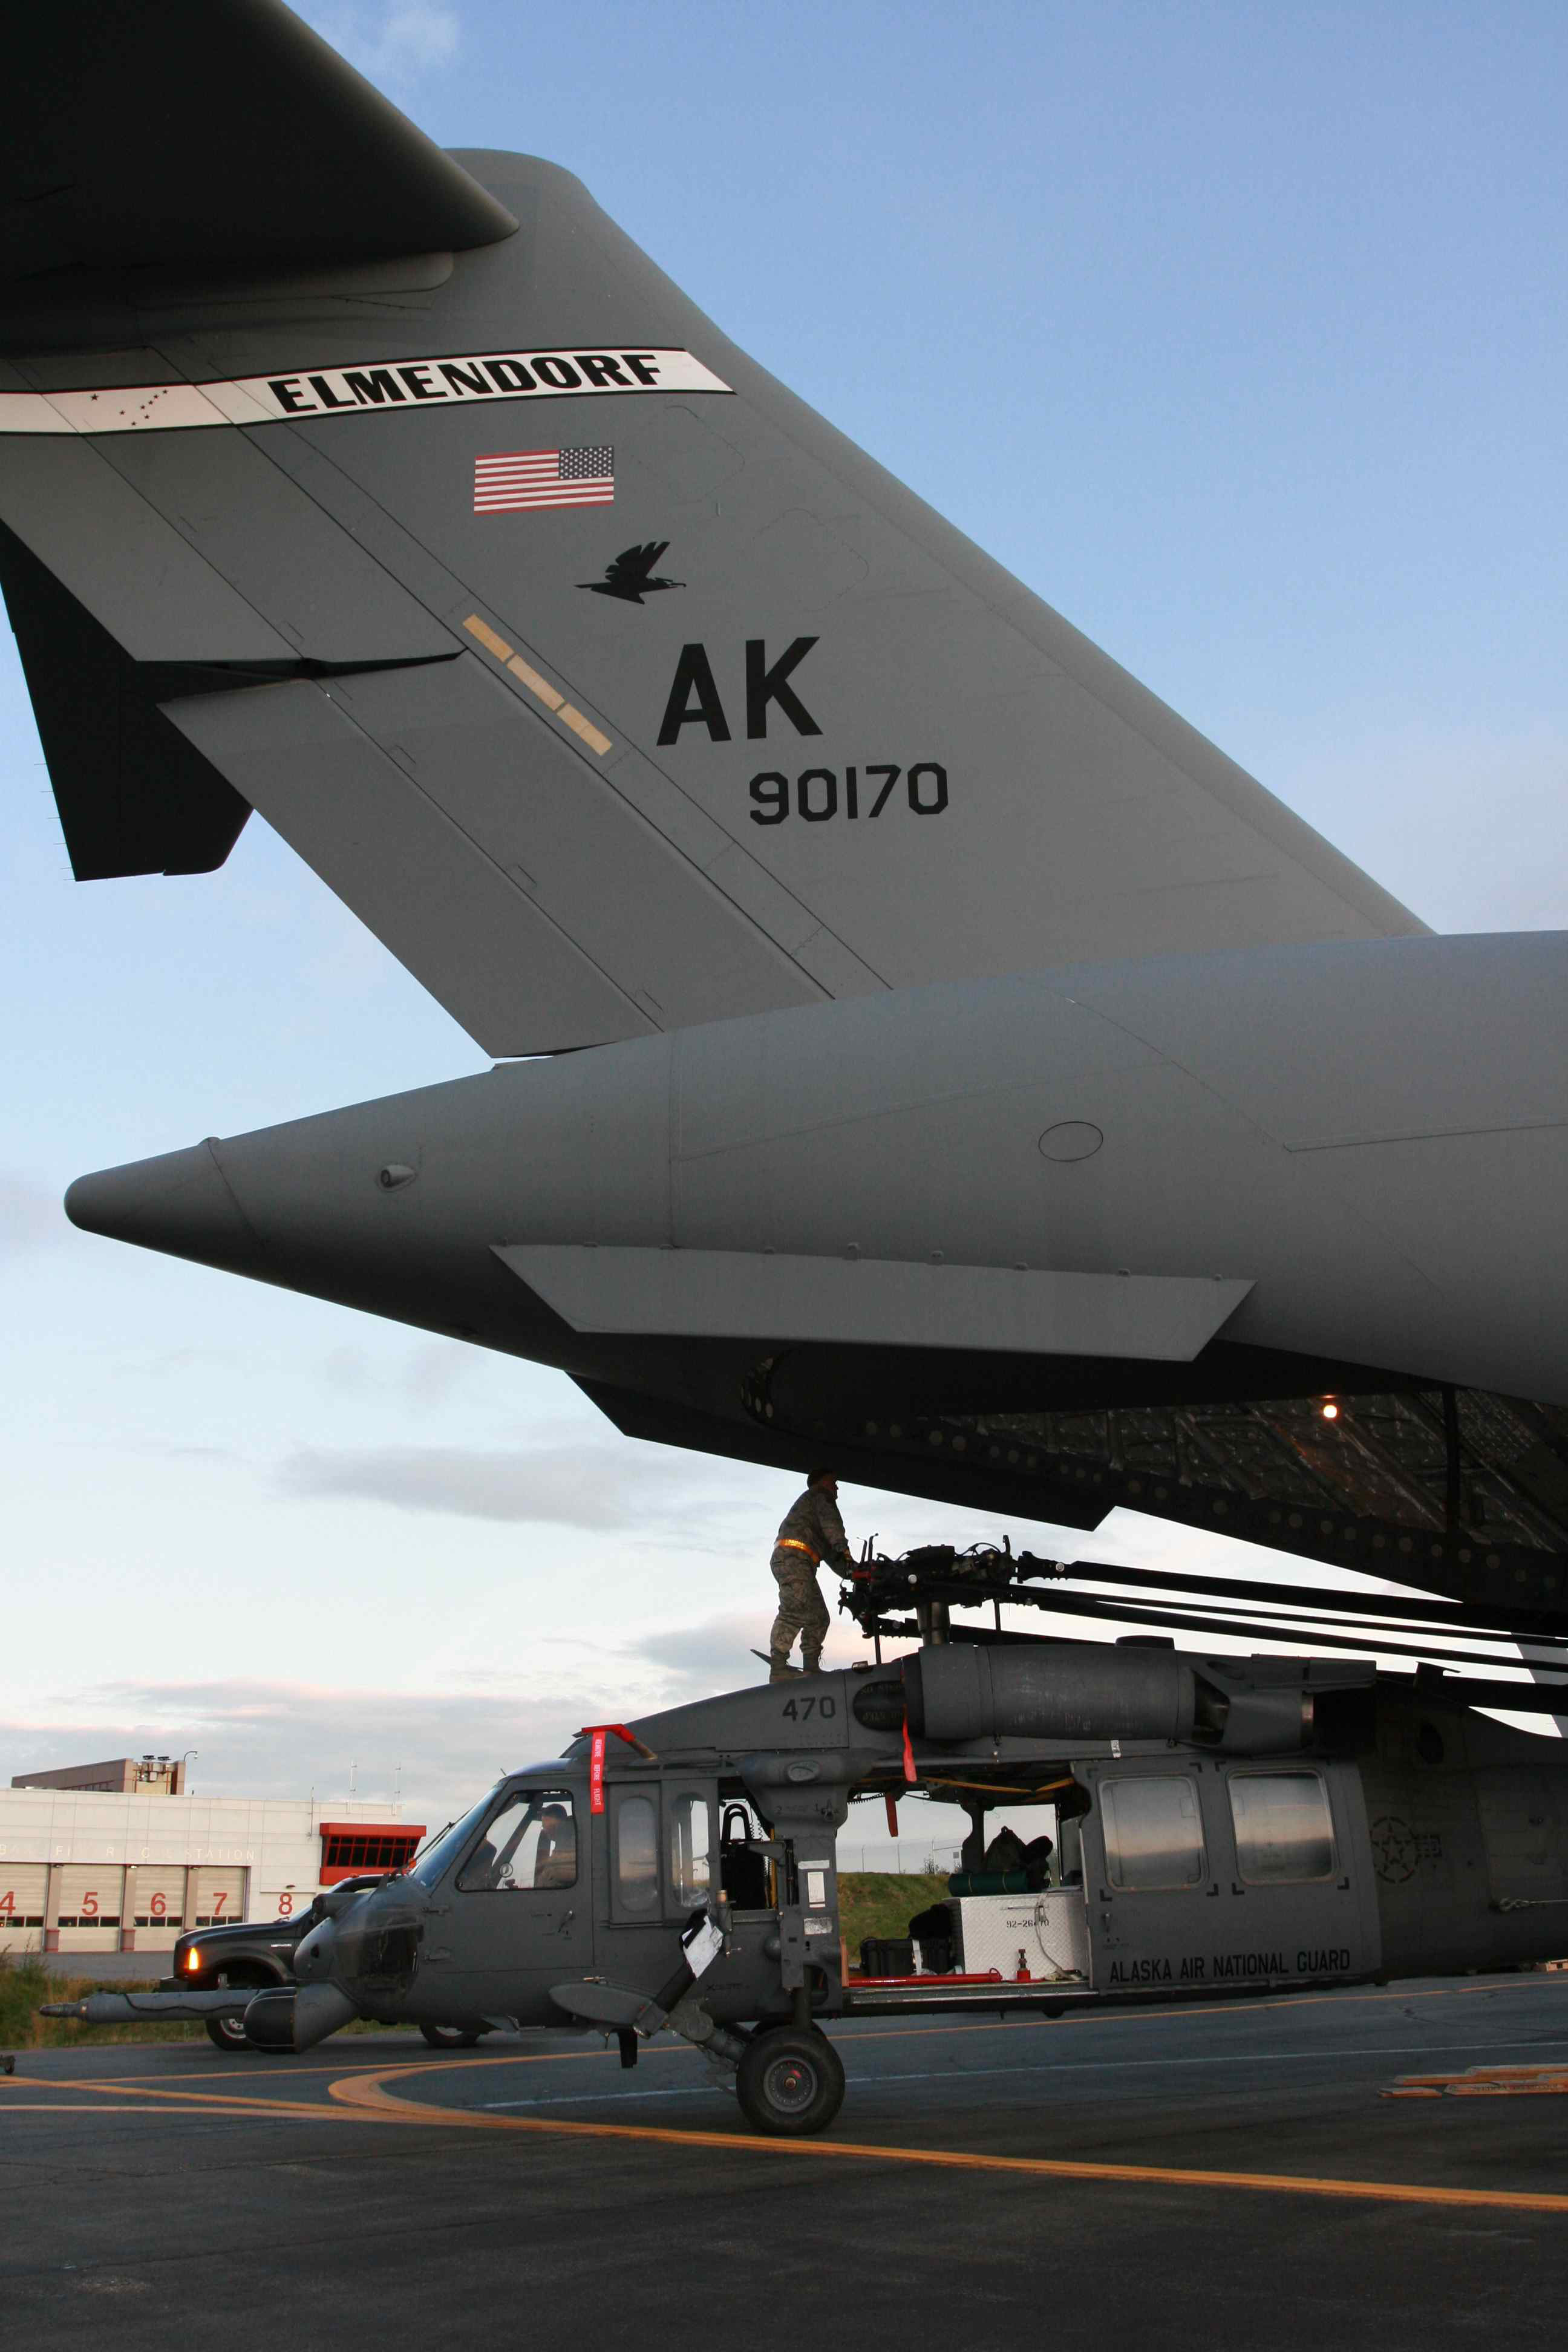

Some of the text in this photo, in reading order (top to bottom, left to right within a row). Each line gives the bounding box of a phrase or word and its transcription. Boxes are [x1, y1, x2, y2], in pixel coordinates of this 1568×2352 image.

[267, 354, 662, 414] ELMENDORF
[656, 636, 824, 746] AK
[750, 762, 949, 826] 90170
[782, 1696, 837, 1722] 470
[185, 1848, 255, 1861] STATION
[0, 1891, 16, 1916] 4
[82, 1892, 98, 1916] 5
[151, 1892, 166, 1916] 6
[213, 1892, 227, 1916] 7
[278, 1893, 293, 1915] 8
[1109, 1949, 1351, 1983] ALASKA AIR NATIONAL GUARD
